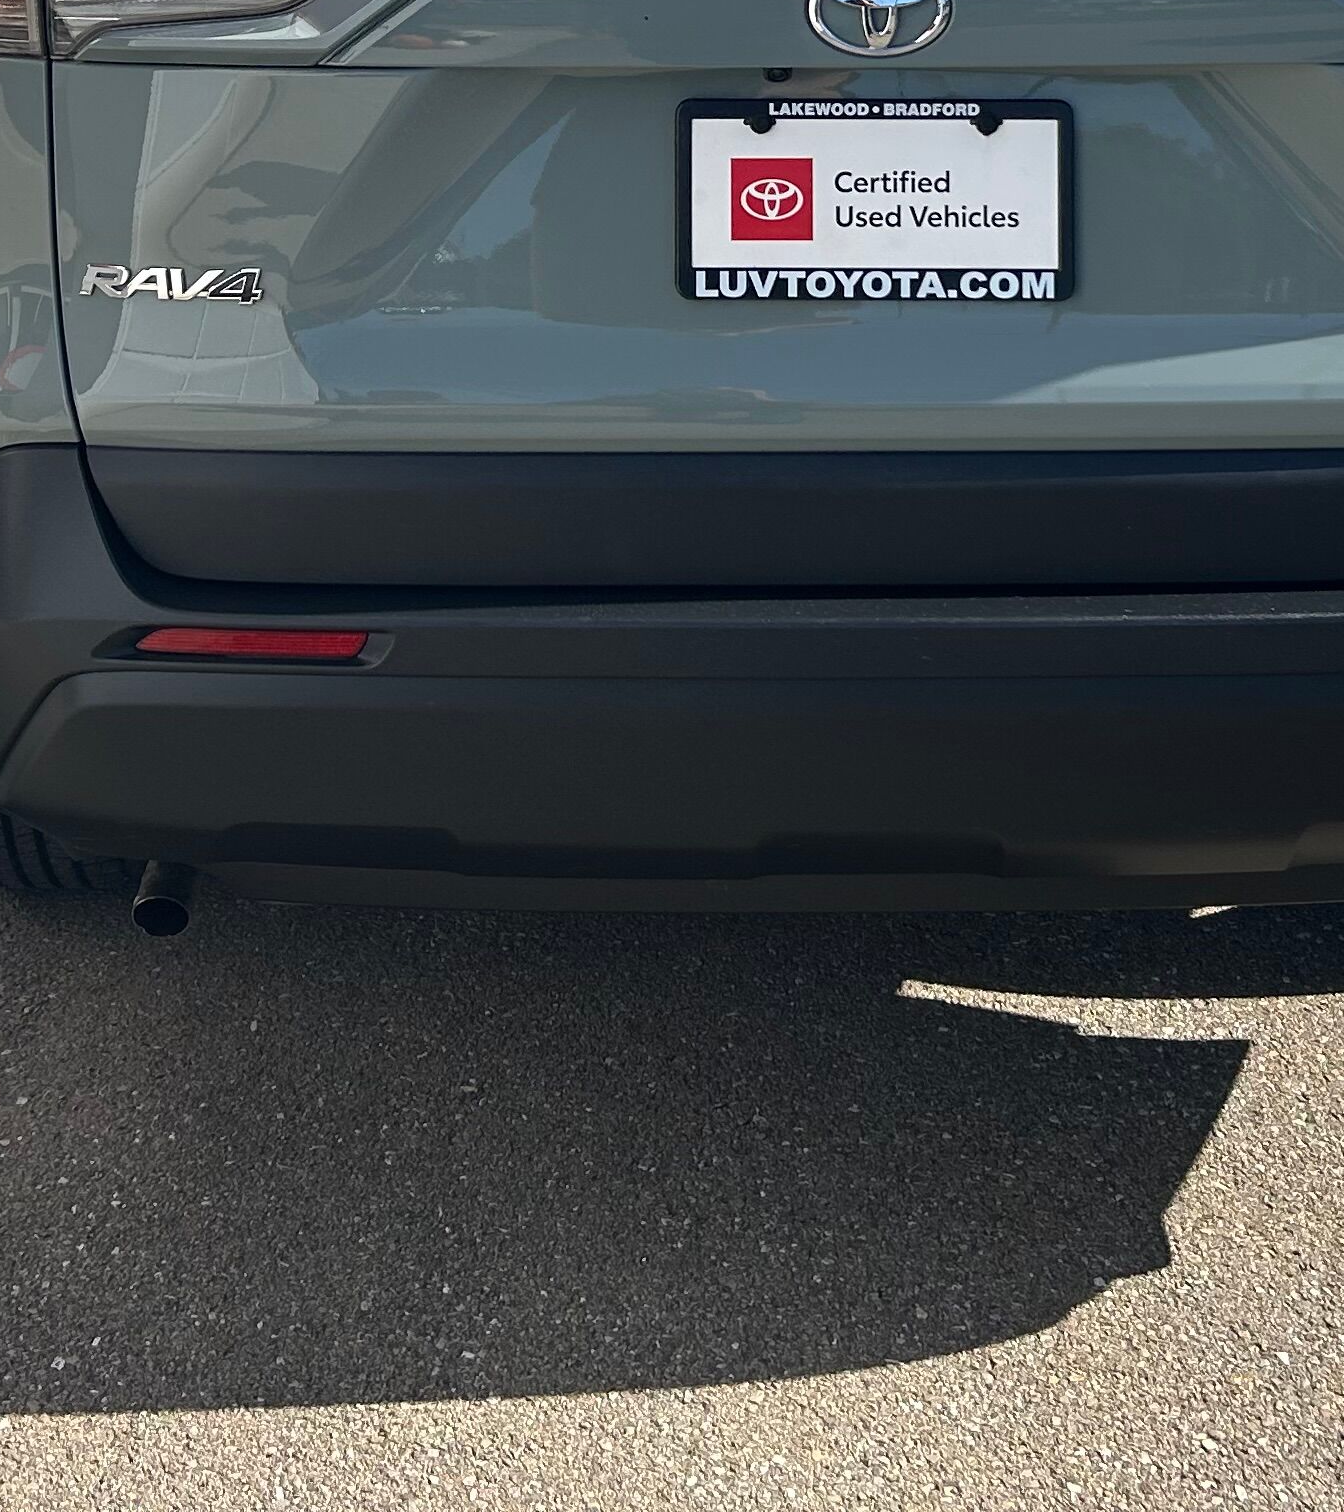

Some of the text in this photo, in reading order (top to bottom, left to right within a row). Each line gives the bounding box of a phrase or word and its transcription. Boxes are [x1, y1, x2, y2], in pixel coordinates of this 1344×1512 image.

[834, 170, 951, 194] Certified
[835, 205, 1020, 229] Used Vehicles
[78, 263, 265, 306] RAV4
[695, 270, 1056, 300] LUVTOYOTA.COM
